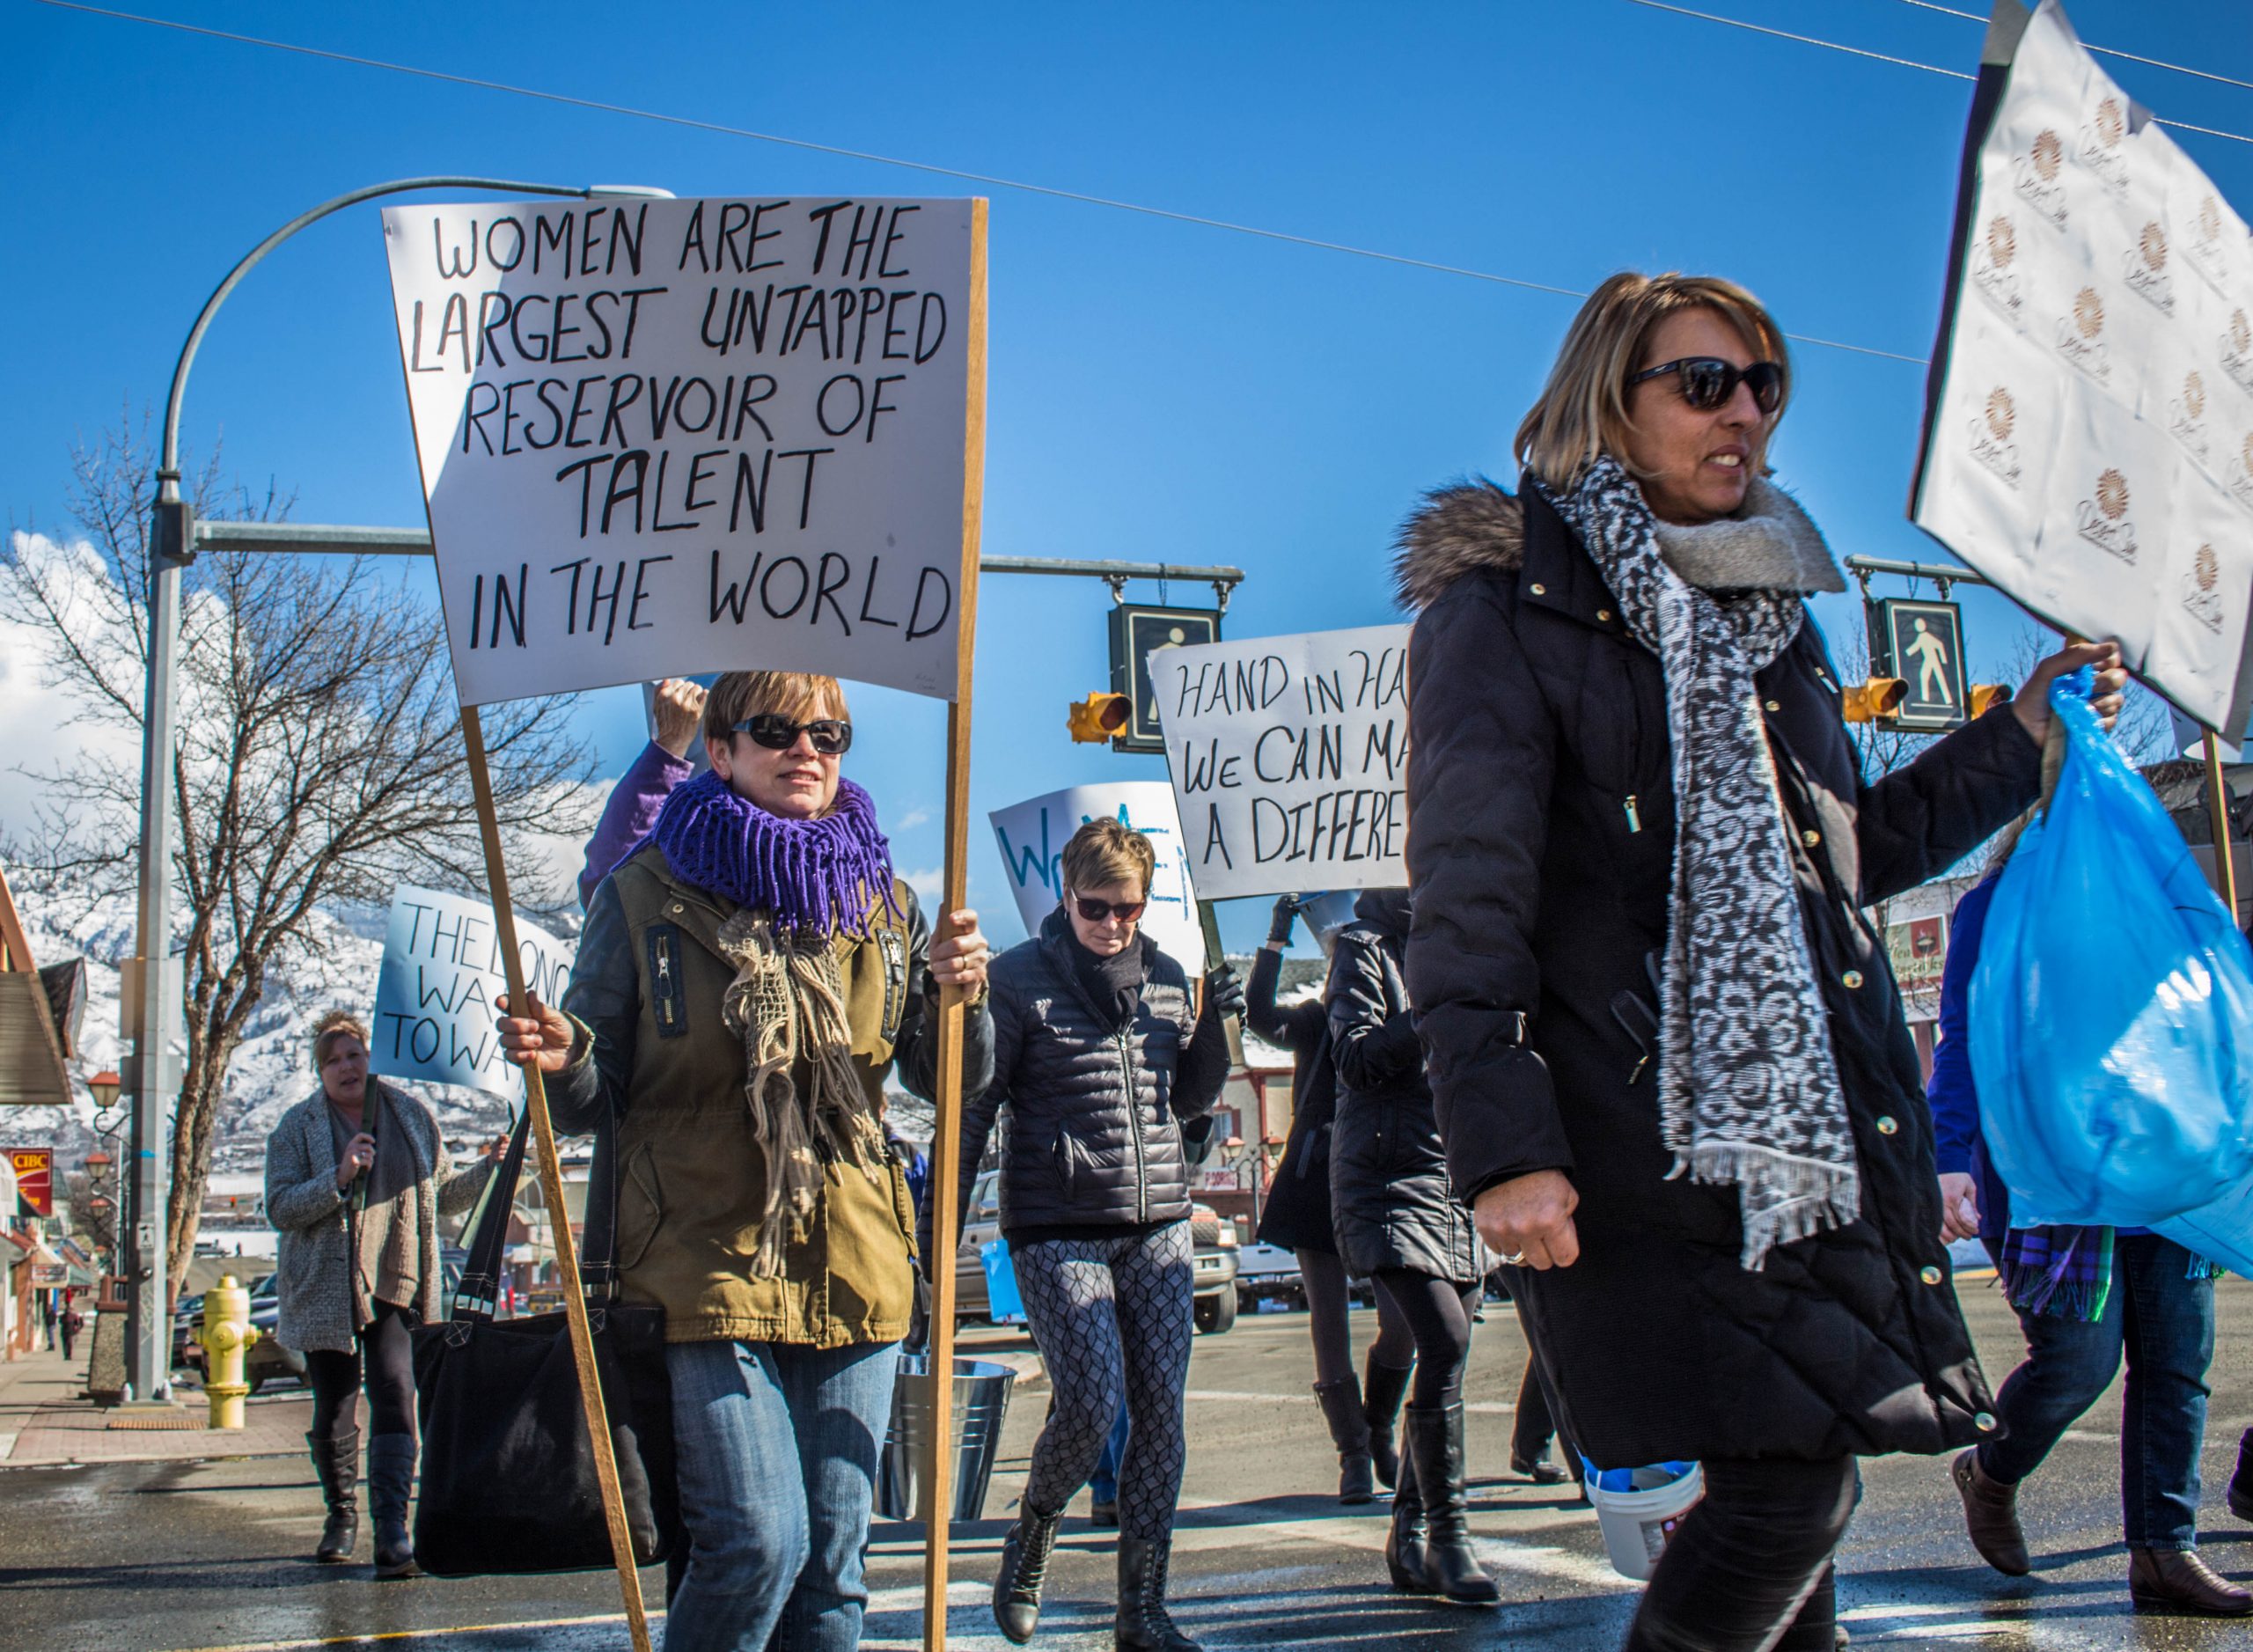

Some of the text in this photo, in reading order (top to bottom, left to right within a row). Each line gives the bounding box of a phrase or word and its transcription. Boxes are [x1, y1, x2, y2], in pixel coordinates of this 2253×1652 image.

[435, 200, 921, 281] WOMEN ARE THE
[412, 284, 948, 373] LARGEST UNTAPPED
[463, 373, 906, 456] RESERVOIR OF
[556, 448, 835, 538] TALENT
[470, 550, 951, 650] IN THE WORLD
[1177, 648, 1408, 718] HAND IN HA
[1185, 738, 1242, 794] WE
[1254, 724, 1342, 784] CAN
[1203, 803, 1232, 870] A
[1251, 789, 1407, 863] DIFFERE
[401, 902, 489, 972] THE
[418, 965, 494, 1024] WA
[382, 1011, 510, 1082] TOWA
[13, 1154, 48, 1169] CIBC
